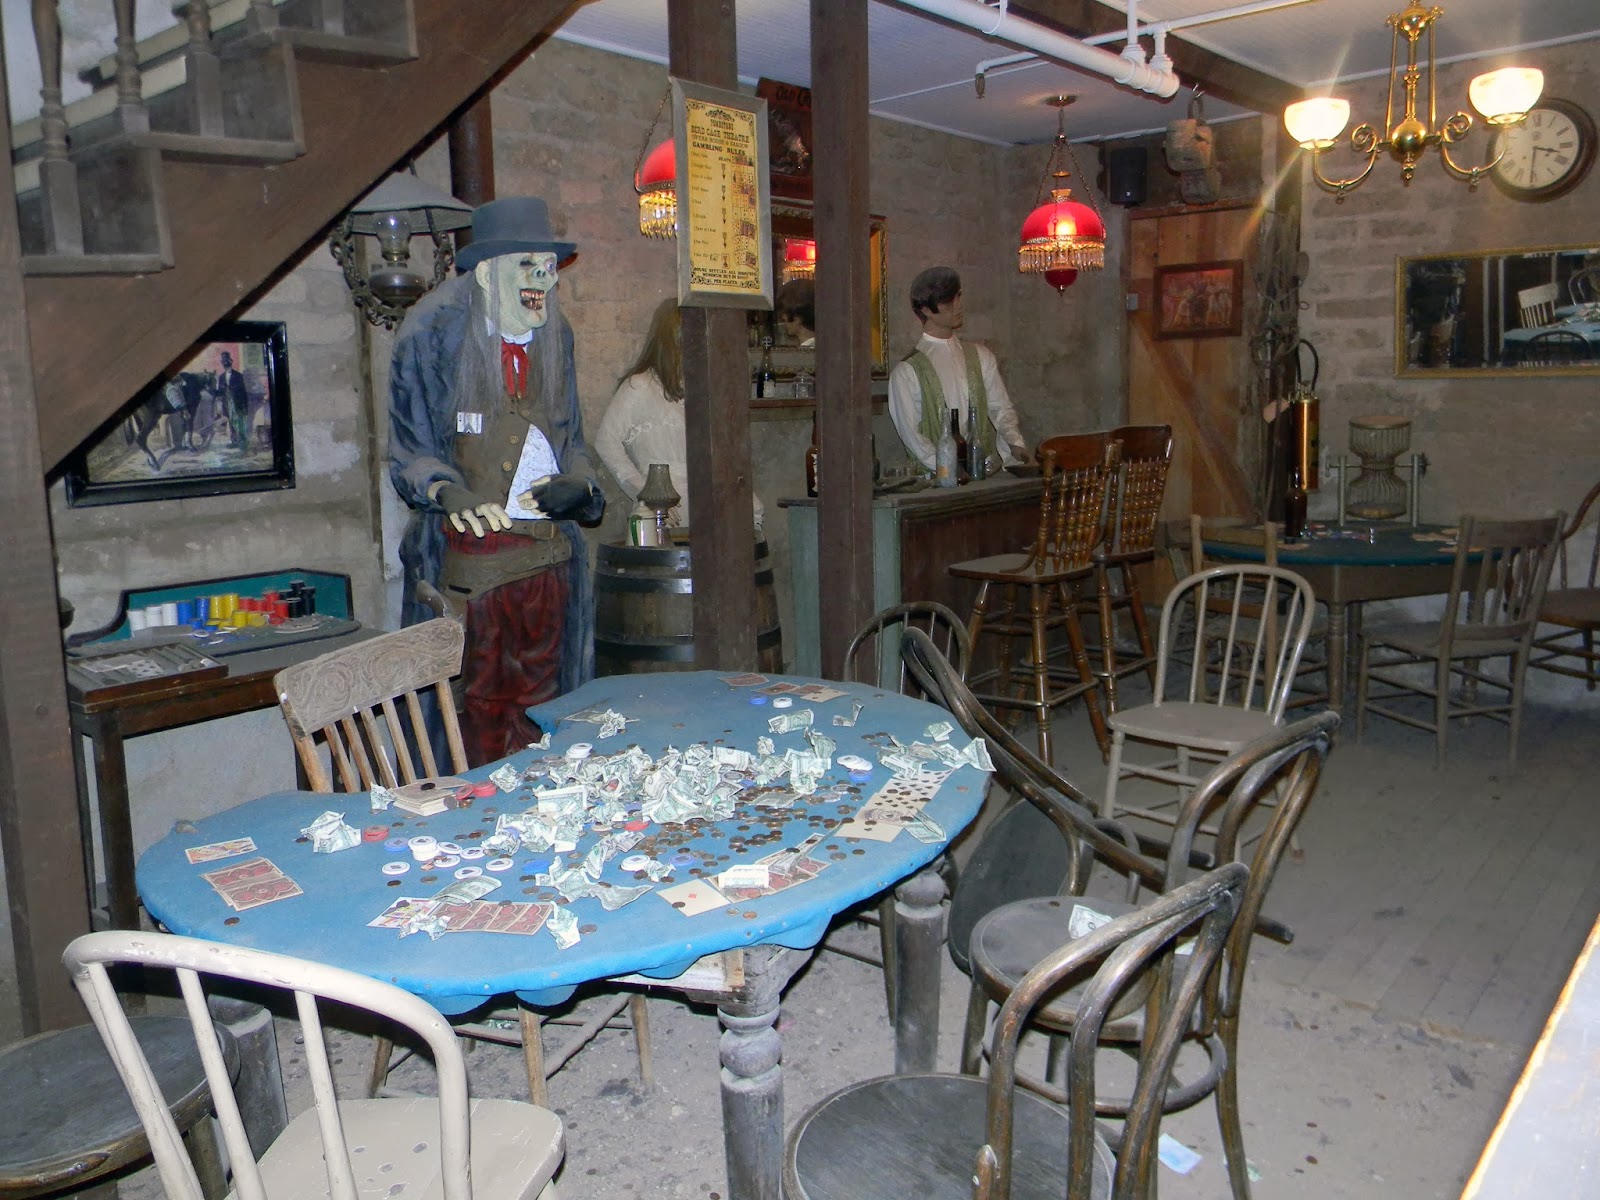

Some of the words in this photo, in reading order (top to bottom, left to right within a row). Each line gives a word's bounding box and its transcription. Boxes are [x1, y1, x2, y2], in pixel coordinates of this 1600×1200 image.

[723, 131, 750, 143] THEATRE
[692, 141, 723, 152] GAMBLING
[726, 147, 746, 156] RULES
